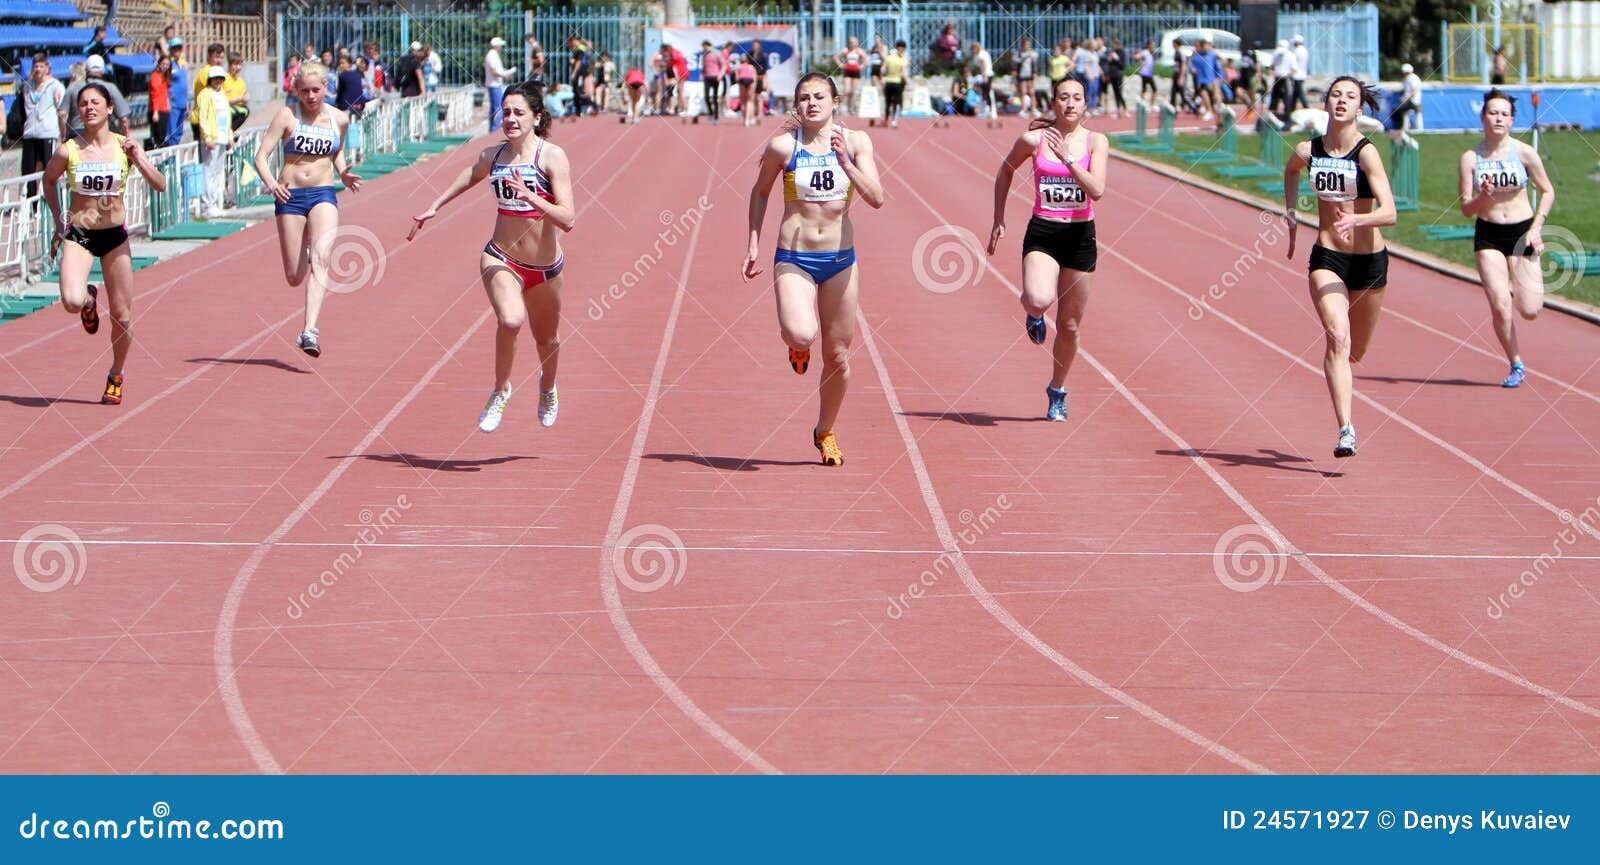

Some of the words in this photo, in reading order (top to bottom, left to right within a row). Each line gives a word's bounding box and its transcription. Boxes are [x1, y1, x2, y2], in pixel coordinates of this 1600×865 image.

[295, 135, 332, 155] 2503
[82, 174, 114, 191] 967
[809, 169, 835, 191] 48
[1315, 171, 1346, 192] 601
[1043, 187, 1086, 203] 1520
